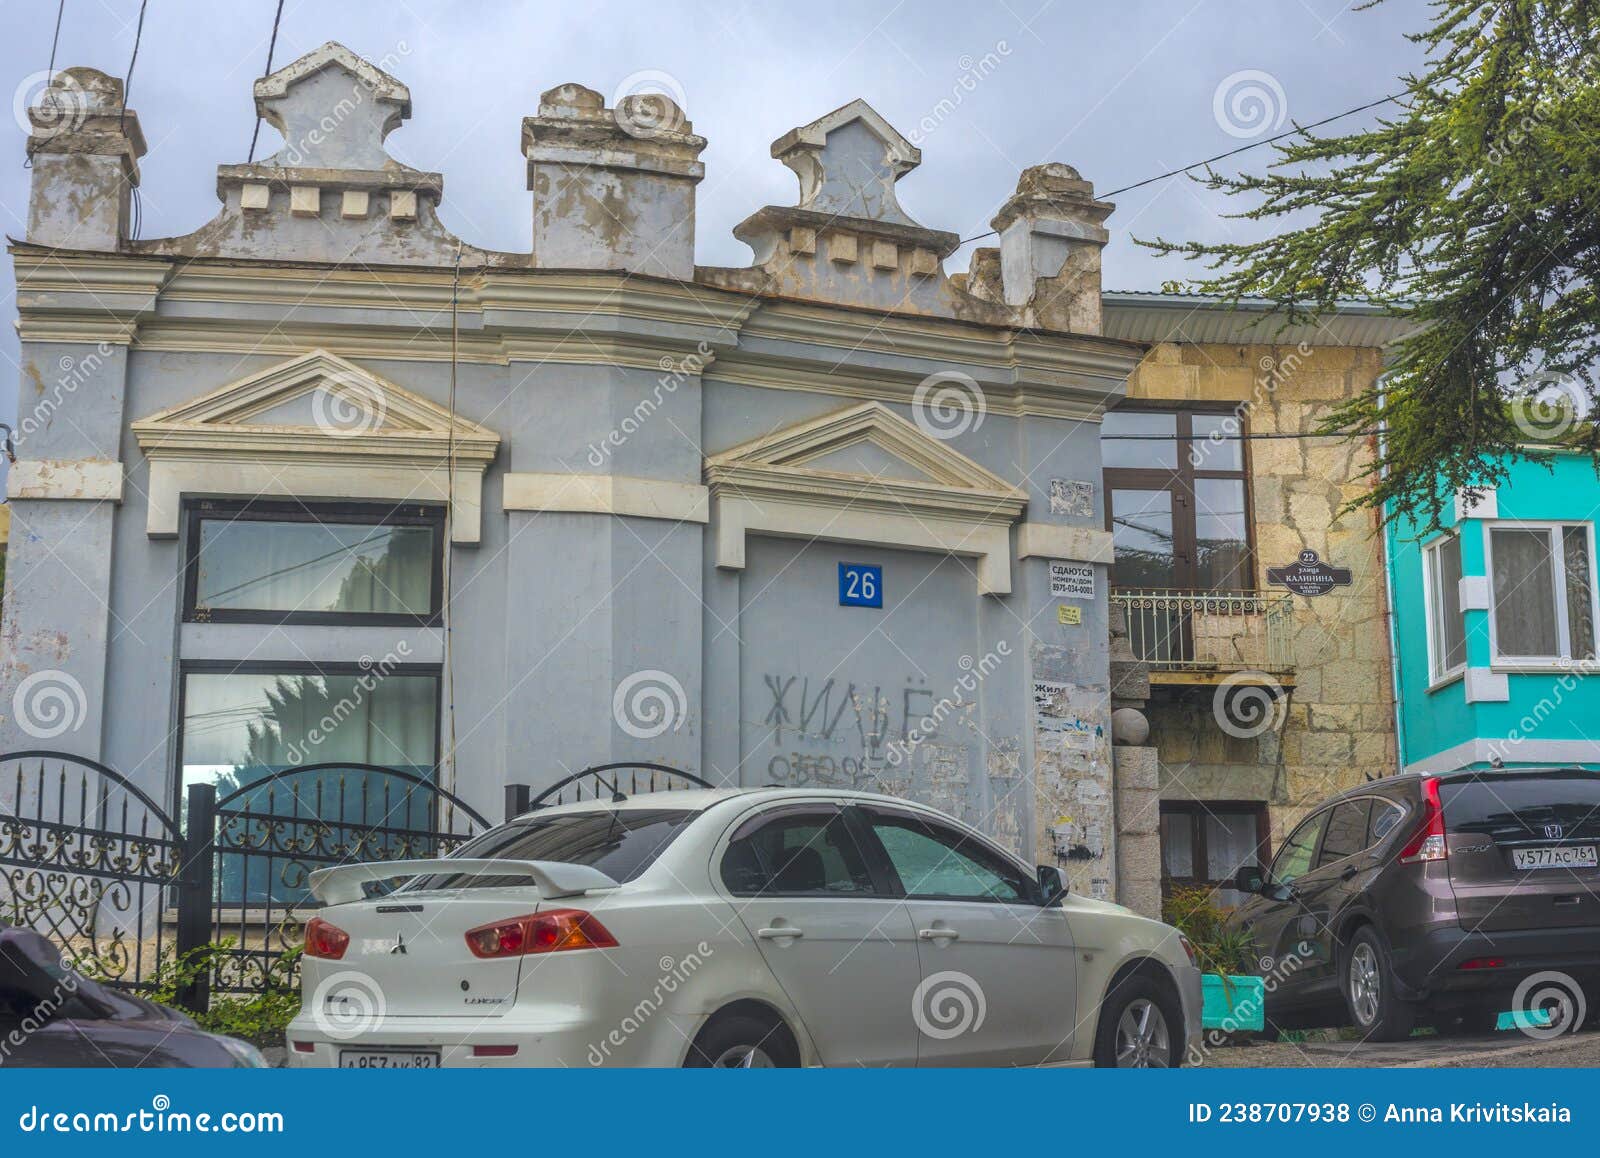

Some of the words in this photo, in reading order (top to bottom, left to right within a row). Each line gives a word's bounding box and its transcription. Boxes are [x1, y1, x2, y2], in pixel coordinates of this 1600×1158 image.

[1303, 553, 1314, 561] 22
[1052, 566, 1093, 577] СДАЮТСЯ
[846, 571, 875, 599] 26
